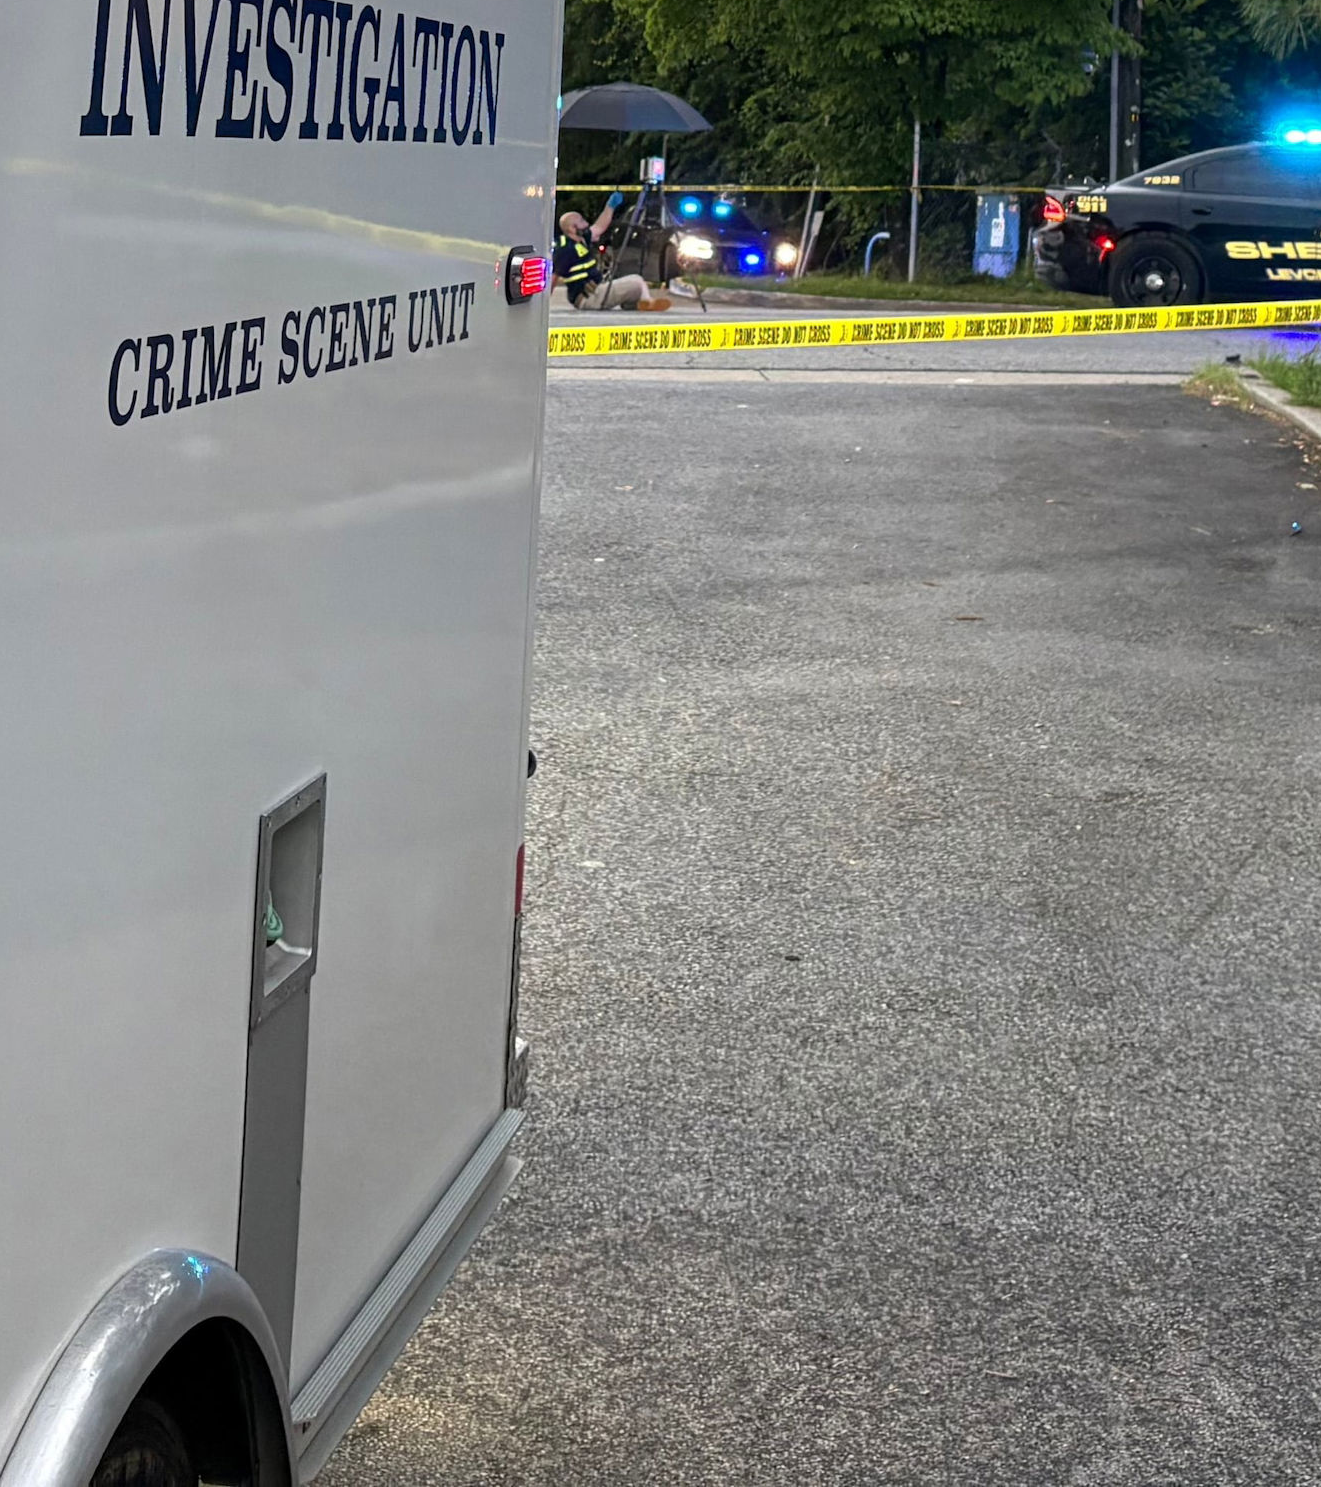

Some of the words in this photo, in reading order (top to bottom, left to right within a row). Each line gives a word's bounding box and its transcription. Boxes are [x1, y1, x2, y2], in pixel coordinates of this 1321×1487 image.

[1076, 201, 1107, 213] 911
[964, 320, 985, 337] CRIME
[986, 319, 1007, 336] SCENE
[1008, 318, 1017, 335] DO
[1018, 318, 1031, 334] NOT
[1032, 316, 1053, 334] CROSS
[1072, 315, 1092, 332] CRIME
[1093, 314, 1113, 331] SCENE
[1114, 313, 1123, 330] DO
[1124, 313, 1136, 329] NOT
[1137, 312, 1157, 329] CROSS
[1175, 311, 1195, 328] CRIME
[1195, 310, 1214, 327] SCENE
[1215, 309, 1224, 325] DO
[1225, 309, 1237, 325] NOT
[1237, 308, 1257, 324] CROSS
[609, 332, 632, 350] CRIME
[634, 331, 658, 350] SCENE
[659, 330, 670, 349] DO
[672, 329, 686, 348] NOT
[687, 328, 711, 347] CROSS
[734, 328, 756, 346] CRIME
[757, 327, 780, 345] SCENE
[781, 327, 791, 344] DO
[792, 326, 806, 344] NOT
[808, 325, 830, 343] CROSS
[852, 324, 873, 341] CRIME
[874, 323, 896, 340] SCENE
[897, 322, 908, 340] DO
[909, 322, 922, 339] NOT
[922, 321, 945, 338] CROSS
[549, 334, 558, 353] OT
[560, 333, 585, 352] CROSS
[108, 317, 265, 426] CRIME
[278, 294, 397, 385] SCENE
[408, 282, 475, 354] UNIT
